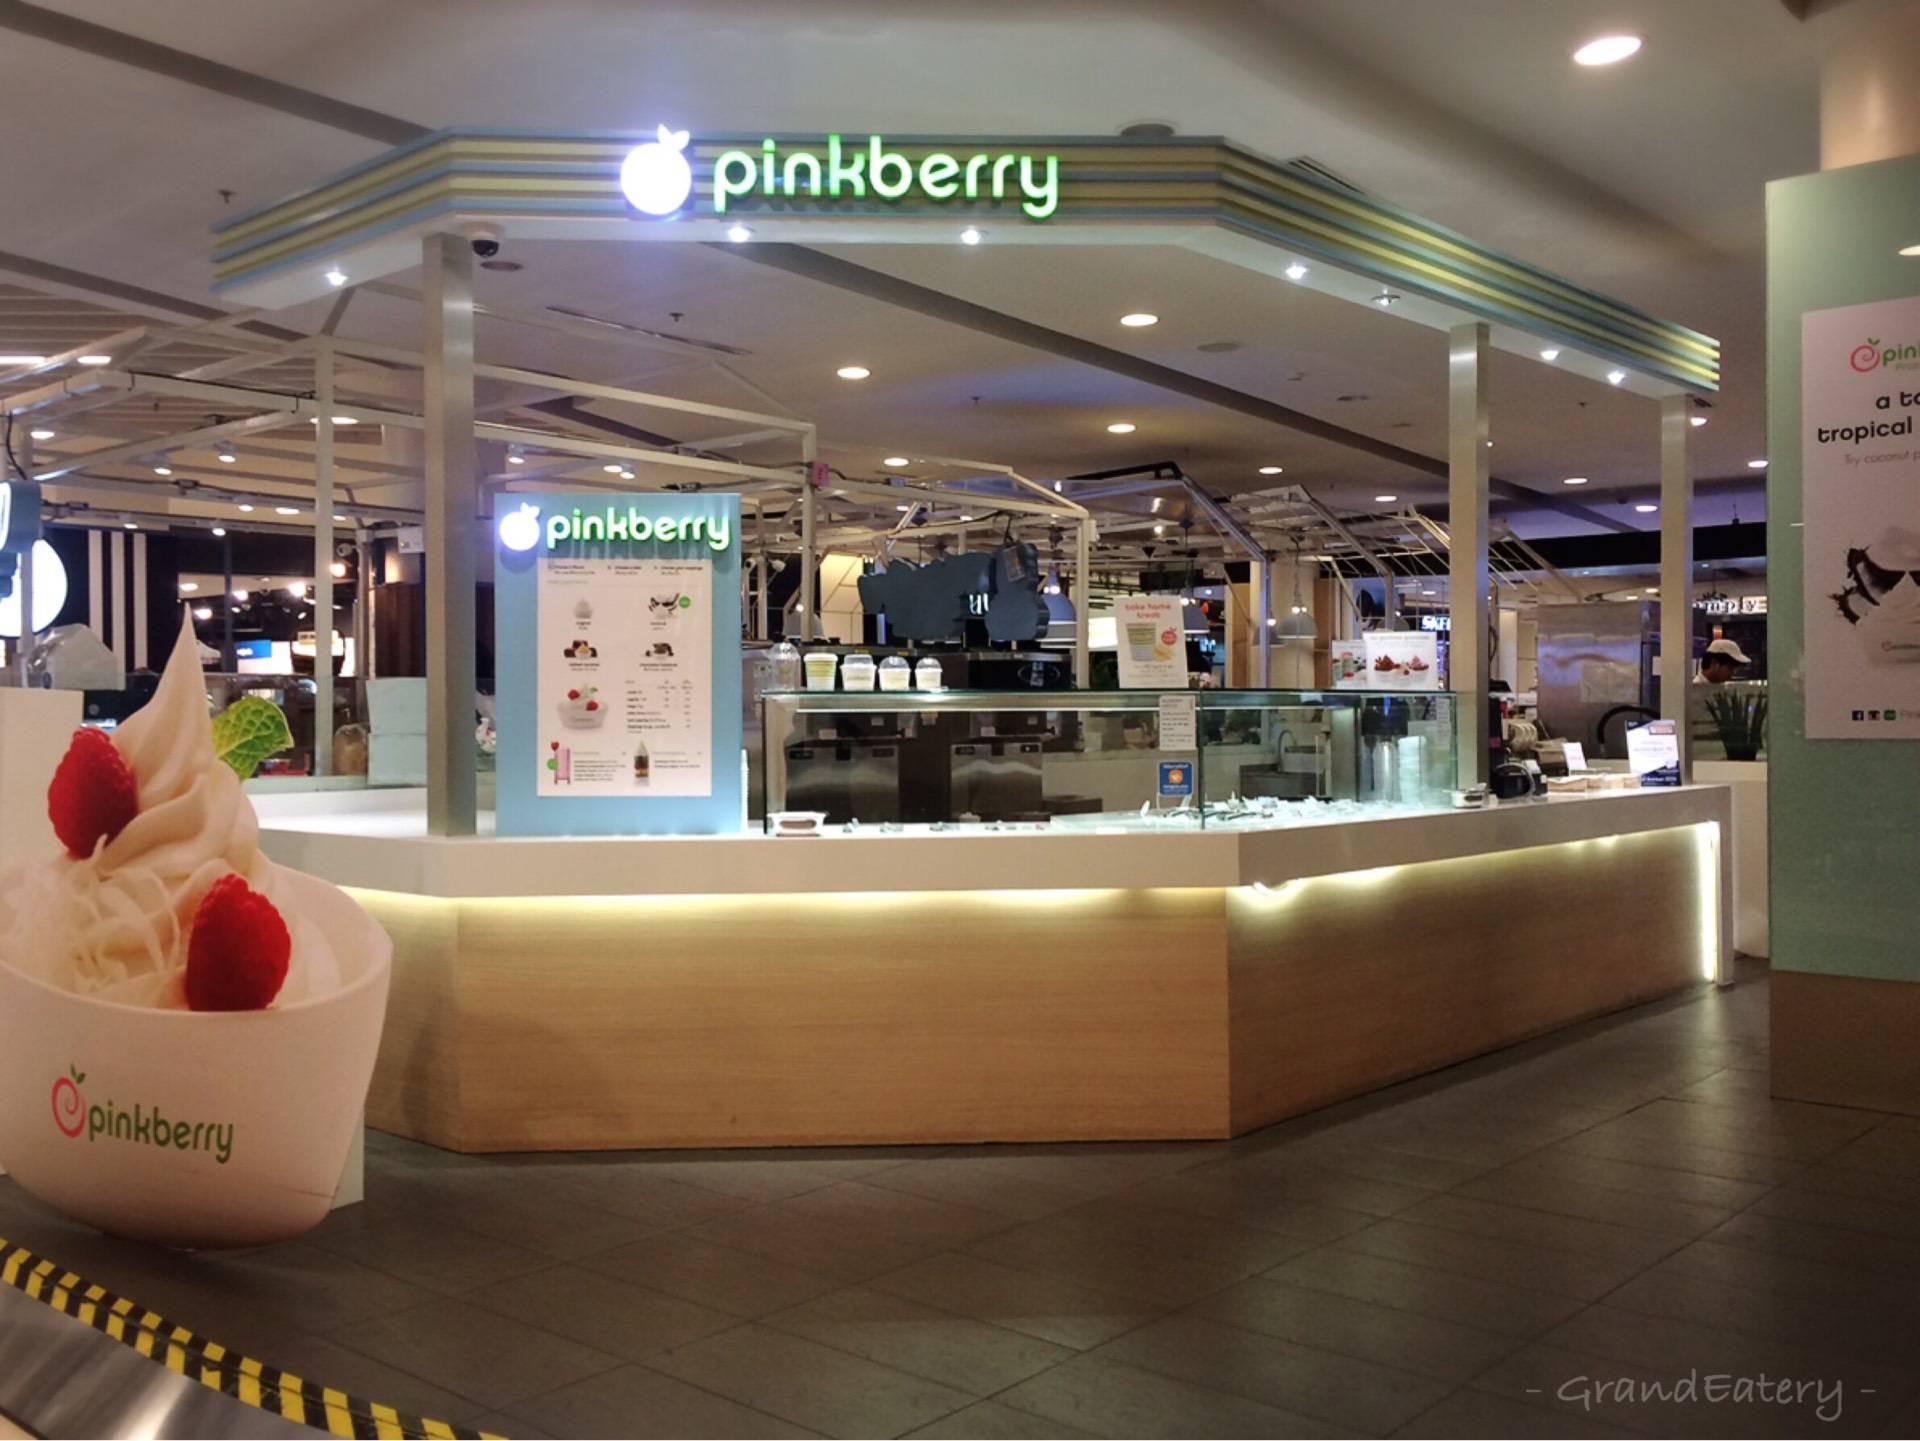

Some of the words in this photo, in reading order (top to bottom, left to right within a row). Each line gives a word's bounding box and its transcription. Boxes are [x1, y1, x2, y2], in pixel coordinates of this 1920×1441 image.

[713, 133, 1059, 219] pinkberry
[1882, 340, 1920, 367] pin
[1875, 395, 1890, 410] a
[1817, 415, 1912, 445] tropical
[546, 506, 731, 551] pinkberry
[88, 1100, 233, 1165] pinkberry
